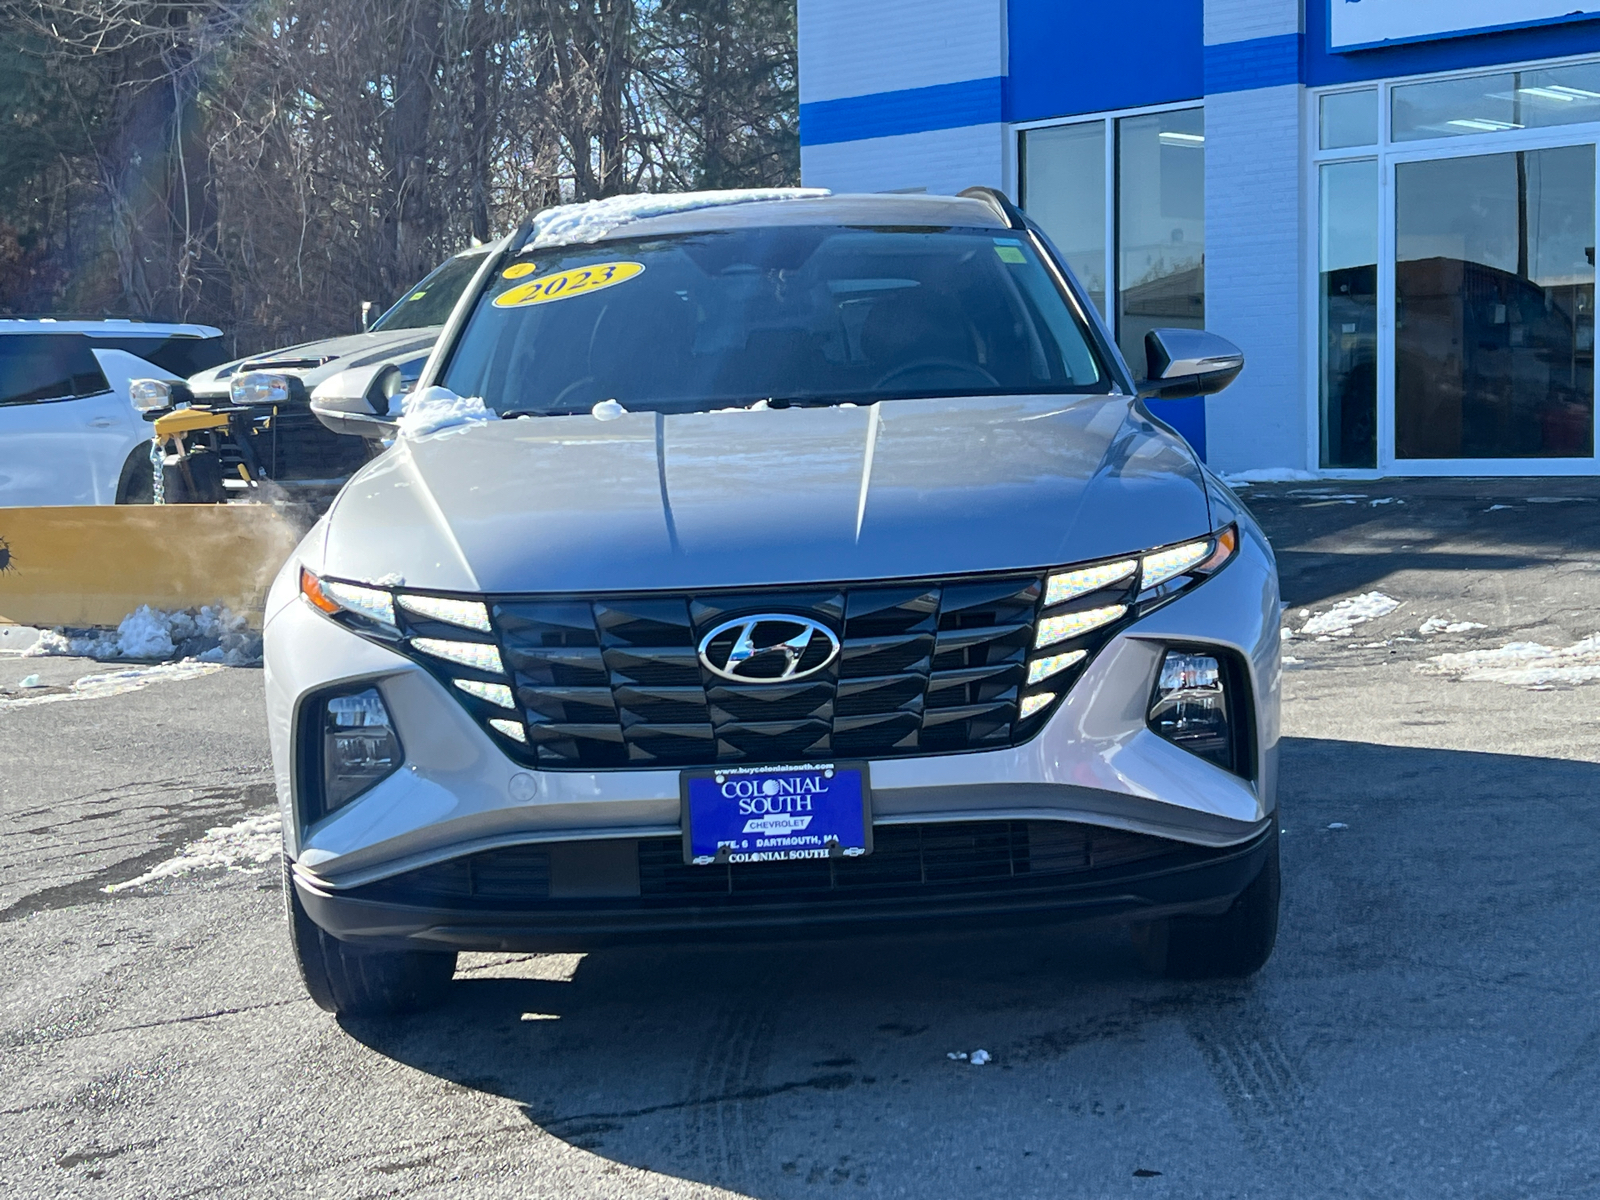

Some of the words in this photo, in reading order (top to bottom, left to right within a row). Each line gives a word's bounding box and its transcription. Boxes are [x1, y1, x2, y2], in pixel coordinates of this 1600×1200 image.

[518, 266, 617, 303] 2023
[714, 763, 834, 775] www.buycolonialsouth.com
[721, 776, 829, 798] COLONIAL
[739, 795, 812, 815] SOUTH
[749, 818, 806, 829] CHEVROLET
[741, 840, 749, 848] 6
[756, 835, 822, 848] DARTMOUTH,
[728, 849, 788, 863] COLONIAL
[789, 848, 830, 860] SOUTH
